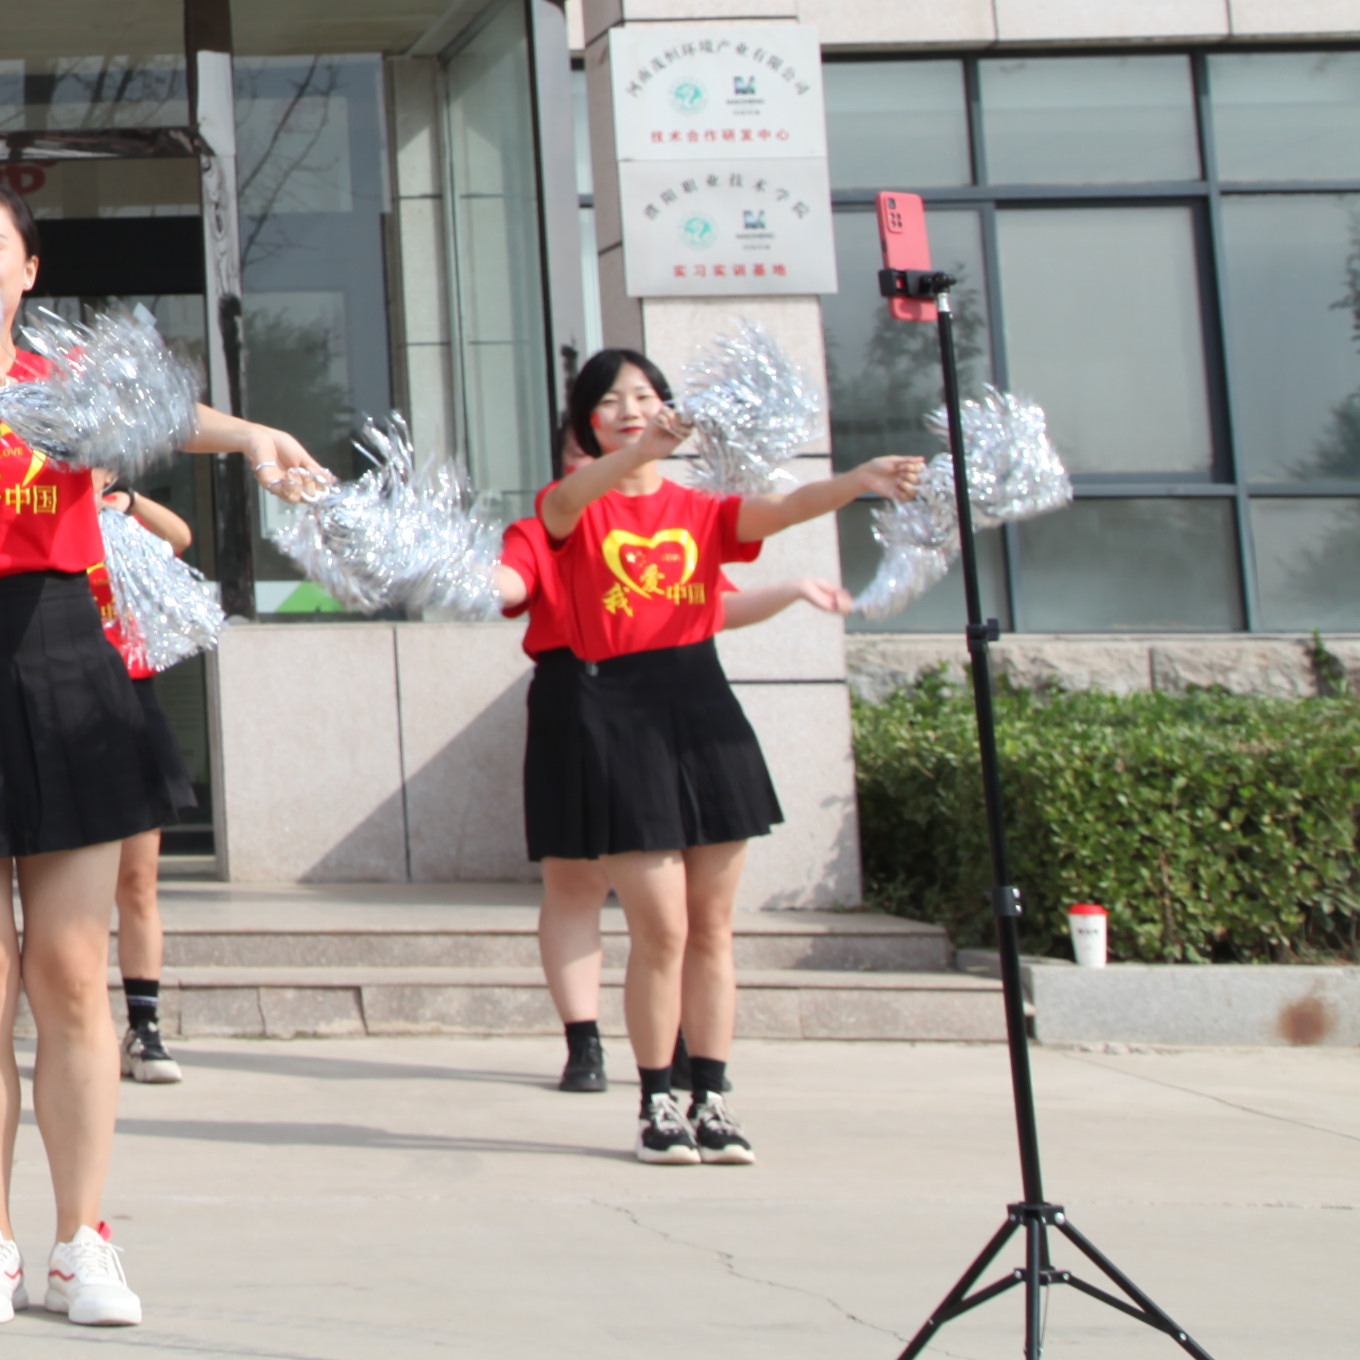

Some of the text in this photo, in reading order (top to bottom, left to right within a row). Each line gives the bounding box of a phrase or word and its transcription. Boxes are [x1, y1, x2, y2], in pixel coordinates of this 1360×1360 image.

[673, 263, 788, 278] 实习实训基地
